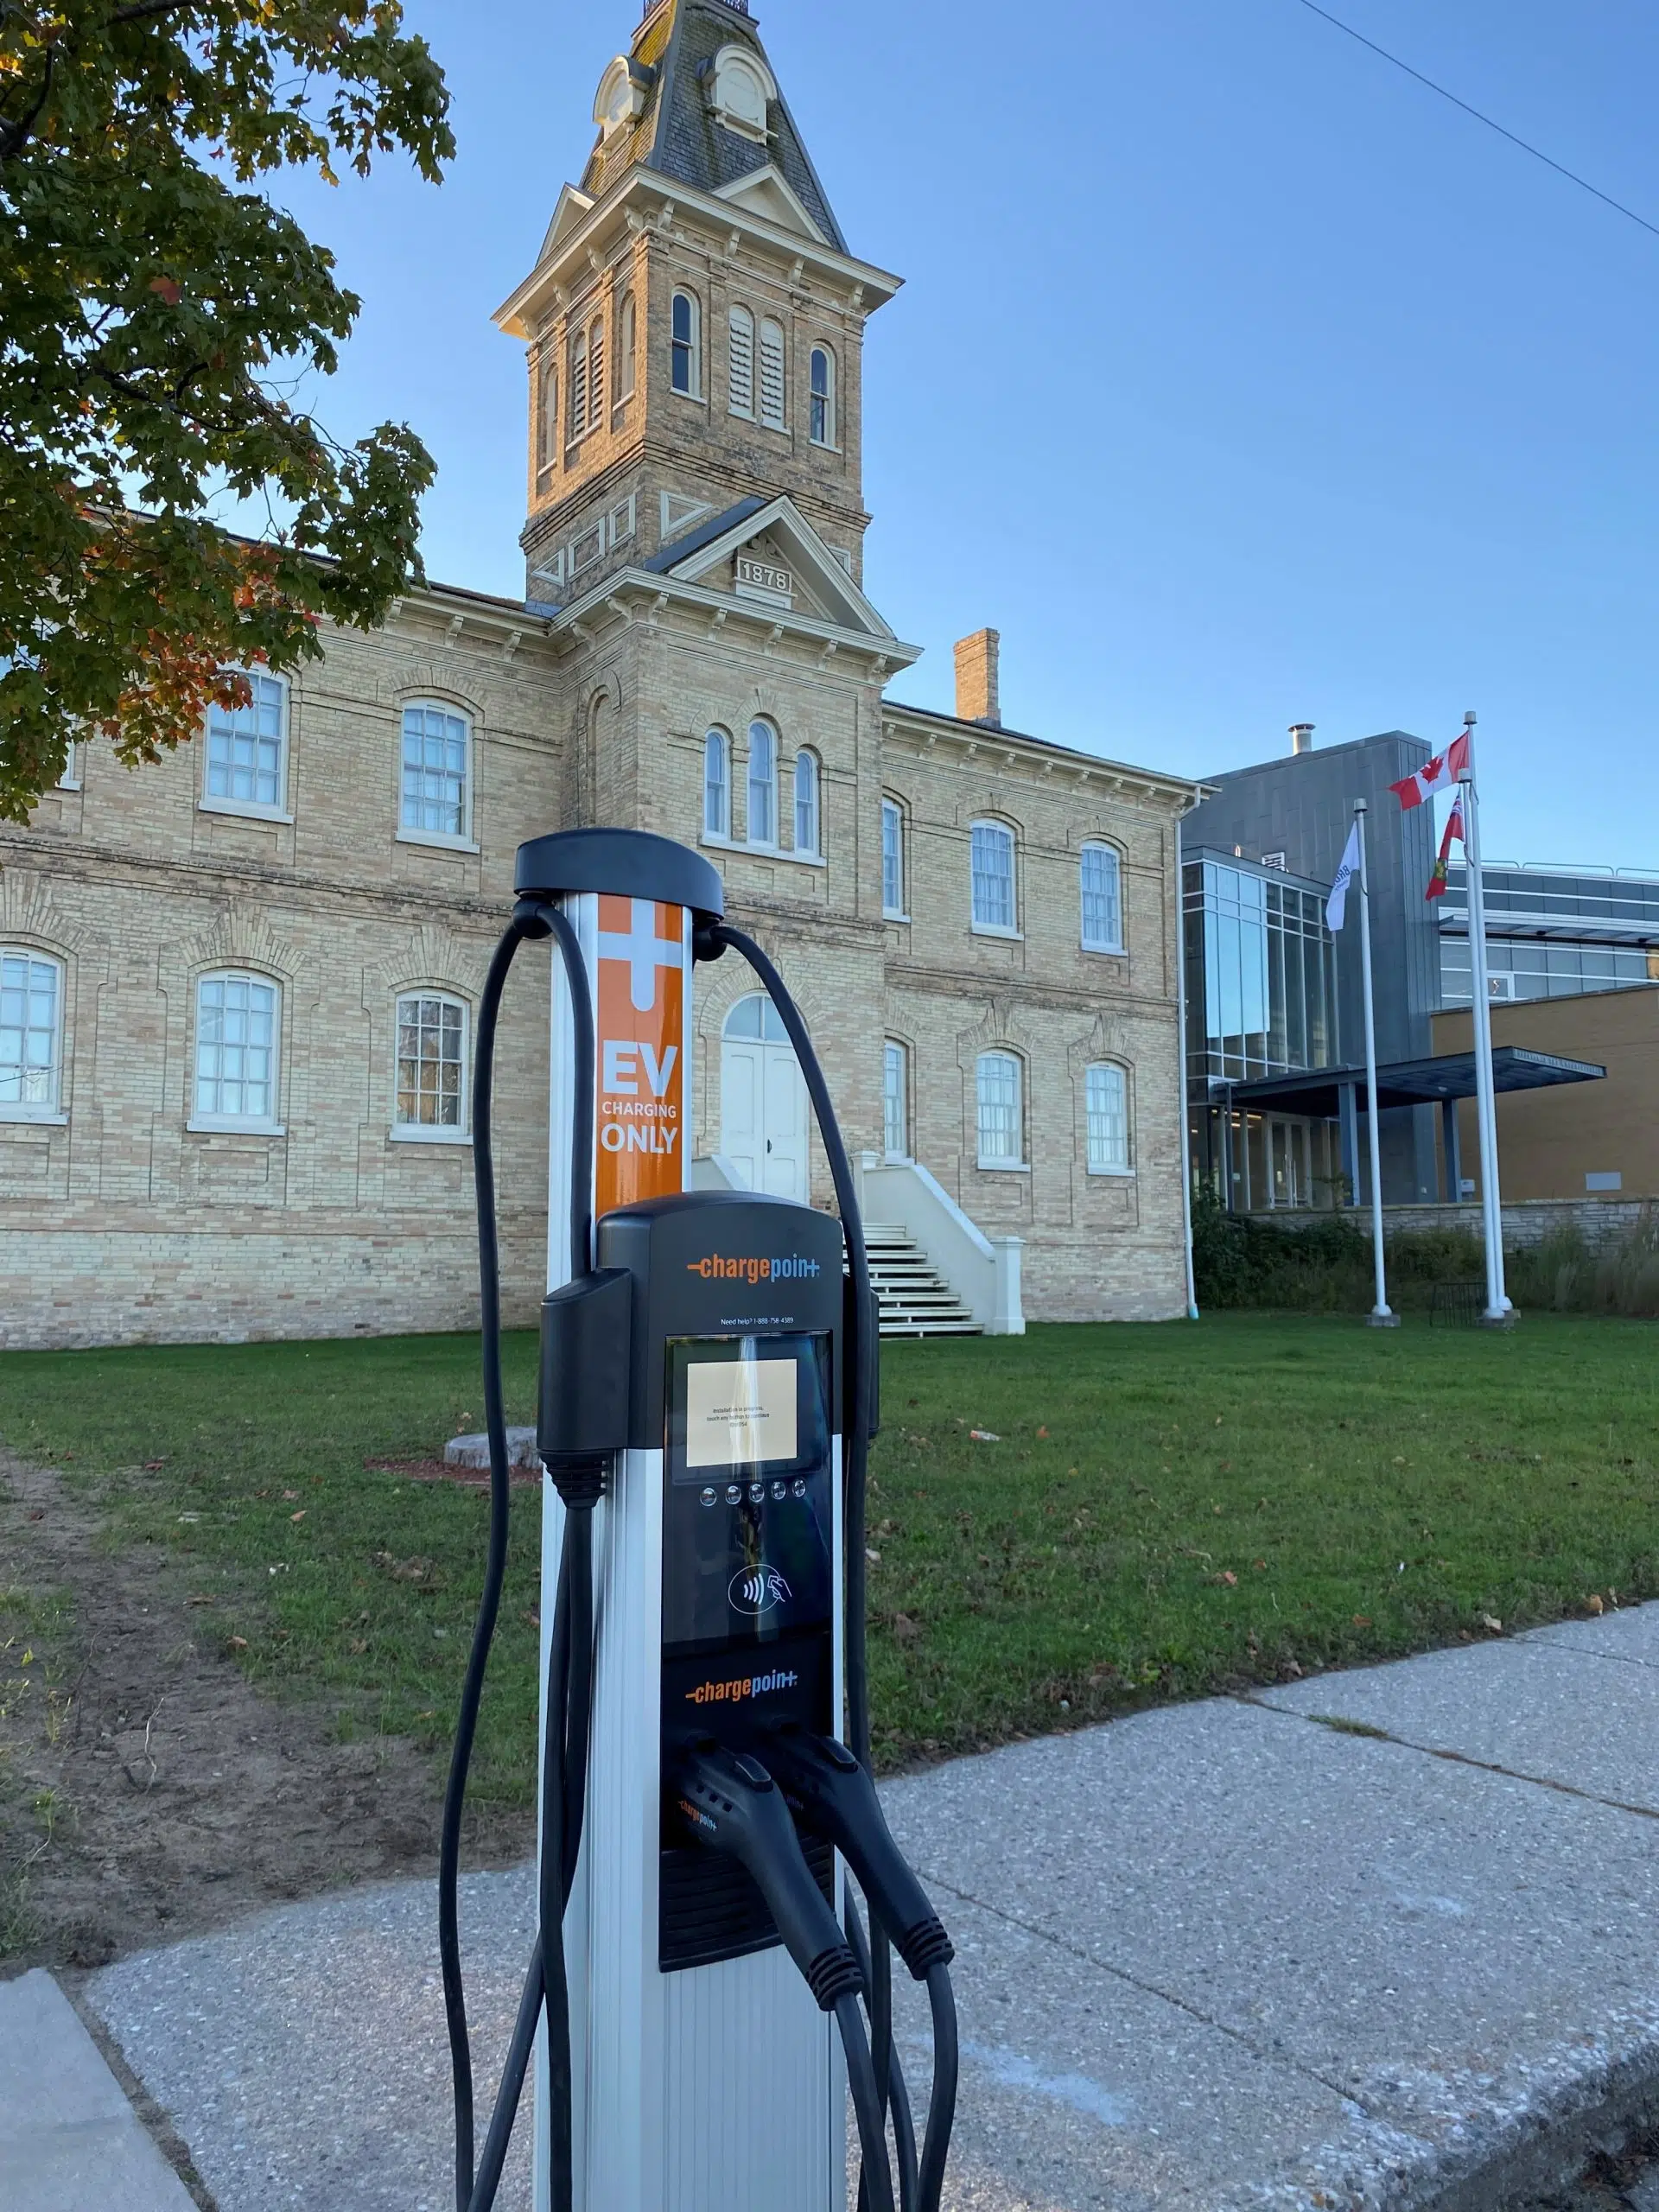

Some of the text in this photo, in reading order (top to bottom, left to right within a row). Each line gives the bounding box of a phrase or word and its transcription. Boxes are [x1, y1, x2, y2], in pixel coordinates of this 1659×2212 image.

[743, 563, 786, 589] 1878
[603, 1039, 678, 1097] EV
[601, 1101, 677, 1118] CHARGING
[601, 1122, 678, 1154] ONLY
